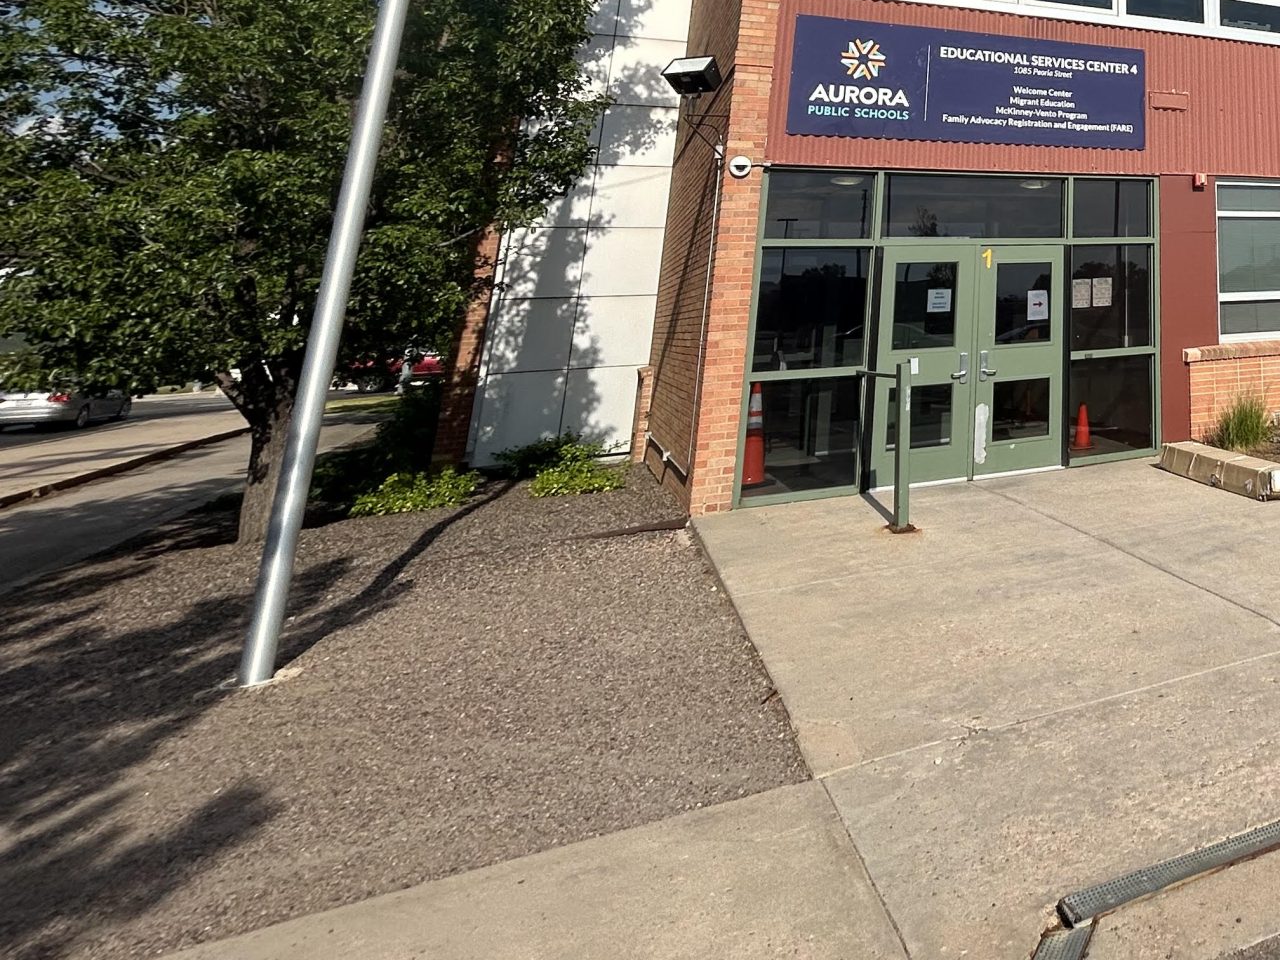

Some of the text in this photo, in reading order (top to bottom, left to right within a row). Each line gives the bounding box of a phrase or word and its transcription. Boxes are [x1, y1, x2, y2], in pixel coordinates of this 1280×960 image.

[940, 46, 1138, 75] EDUCATIONAL SERVICES CENTER 4
[1014, 66, 1073, 79] 1085 Peoria Street
[808, 83, 910, 107] AURORA
[1013, 85, 1073, 98] Welcome Center
[1010, 96, 1075, 109] Migrant Education
[808, 105, 910, 120] PUBLIC SCHOOLS
[995, 106, 1088, 120] McKinney-Vento Program
[942, 114, 1134, 134] Family Advocacy Registration and Engagement (FARE)
[982, 248, 992, 269] 1
